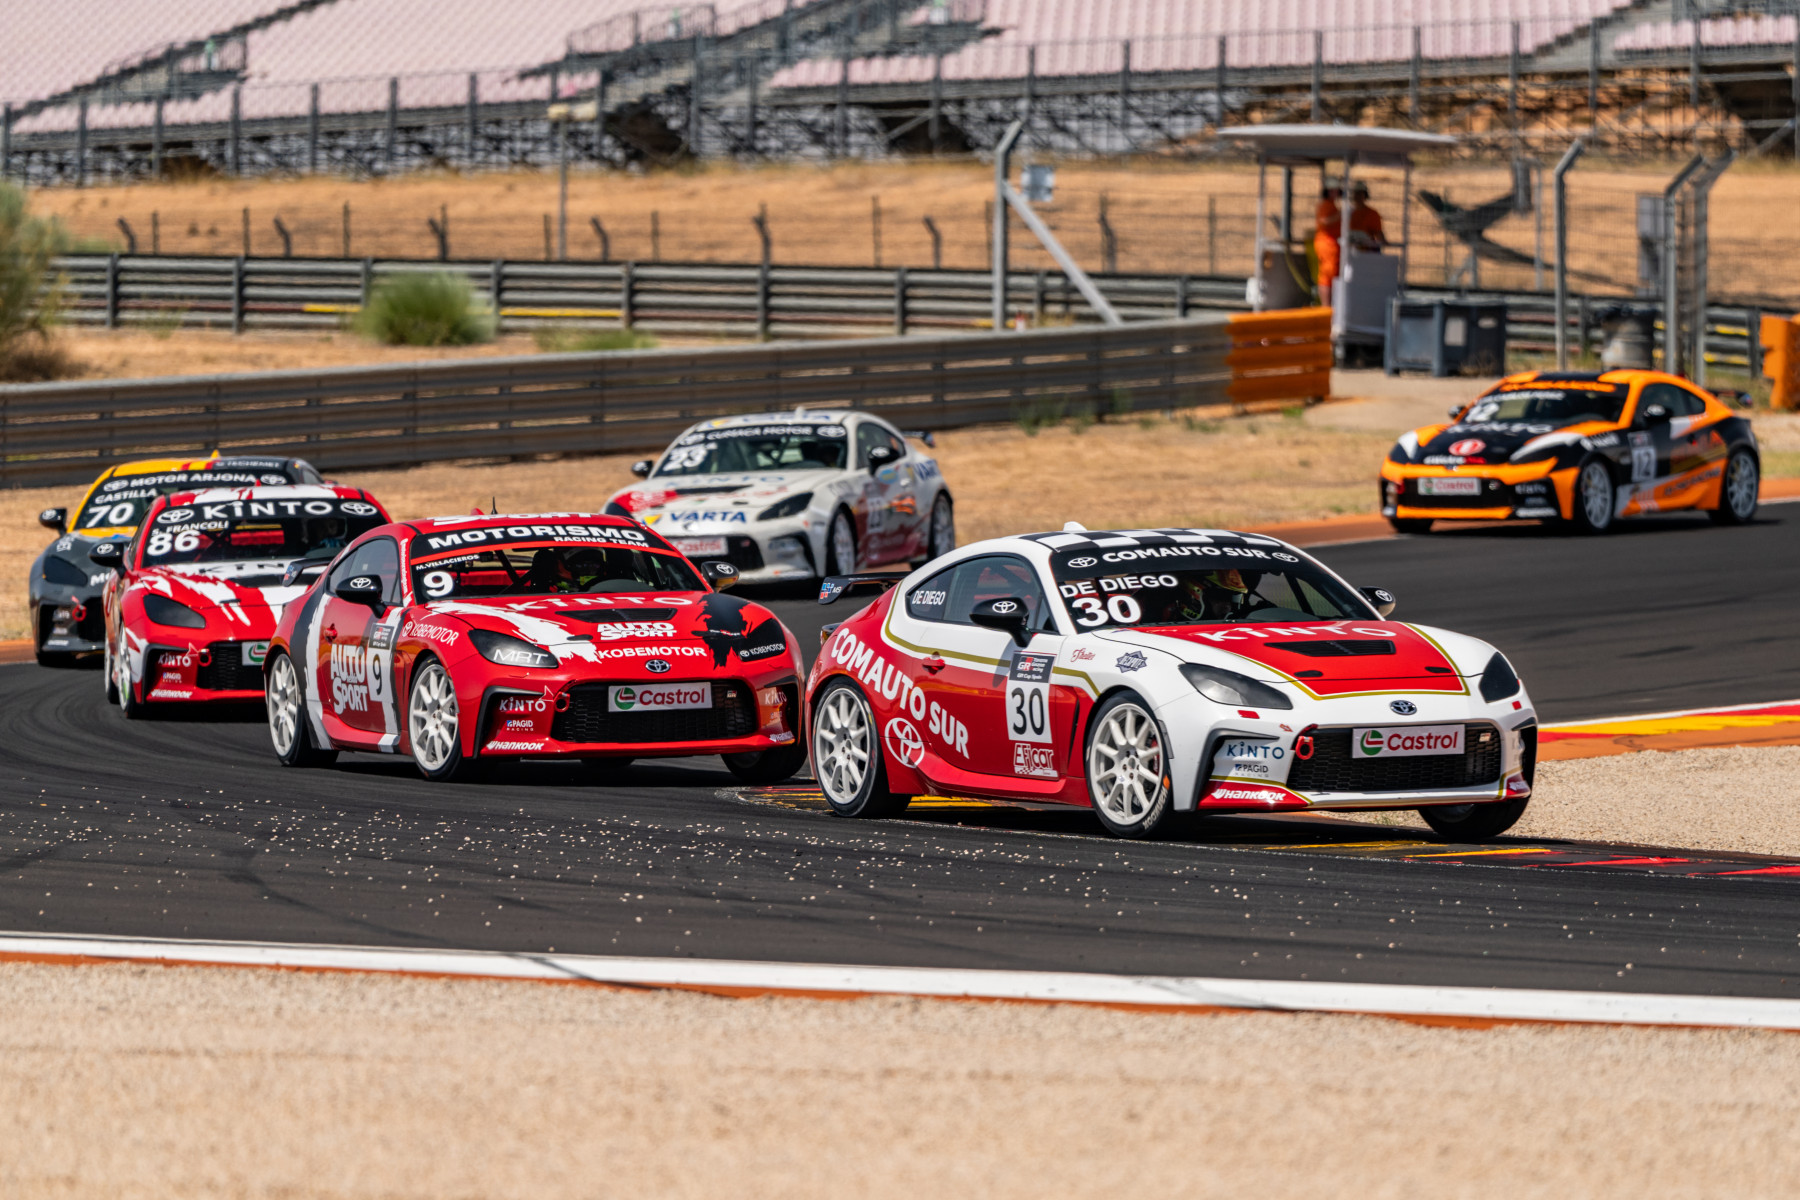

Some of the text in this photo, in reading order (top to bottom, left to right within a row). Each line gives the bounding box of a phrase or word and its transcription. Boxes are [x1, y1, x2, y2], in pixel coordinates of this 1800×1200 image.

[130, 472, 257, 488] MOTOR ARJONA
[94, 488, 158, 505] CASTILLA
[86, 502, 135, 528] 70
[670, 511, 747, 524] VARTA
[166, 520, 230, 534] FRANCOLI
[147, 530, 201, 556] 86
[427, 525, 646, 549] MOTORISMO
[553, 536, 649, 548] RACING TEAM
[1102, 546, 1271, 562] COMAUTO SUR
[423, 571, 454, 597] 9
[1059, 574, 1178, 598] DE DIEGO
[912, 590, 947, 605] DE DIEGO
[1072, 595, 1141, 627] 30
[409, 622, 460, 647] KOBEMOTOR
[597, 622, 675, 633] AUTO
[600, 630, 677, 641] SPORT
[493, 649, 549, 665] MRT
[597, 646, 708, 659] KOBEMOTOR
[748, 643, 786, 656] KOBEMOTOR
[330, 644, 365, 683] AUTO
[372, 653, 383, 696] 9
[831, 628, 926, 721] COMAUTO
[332, 676, 368, 715] SPORT
[639, 687, 705, 706] Castrol
[1011, 687, 1045, 736] 30
[512, 720, 534, 728] PAGID
[928, 701, 970, 760] SUR
[1387, 731, 1458, 751] Castrol
[1241, 764, 1269, 773] PAGID
